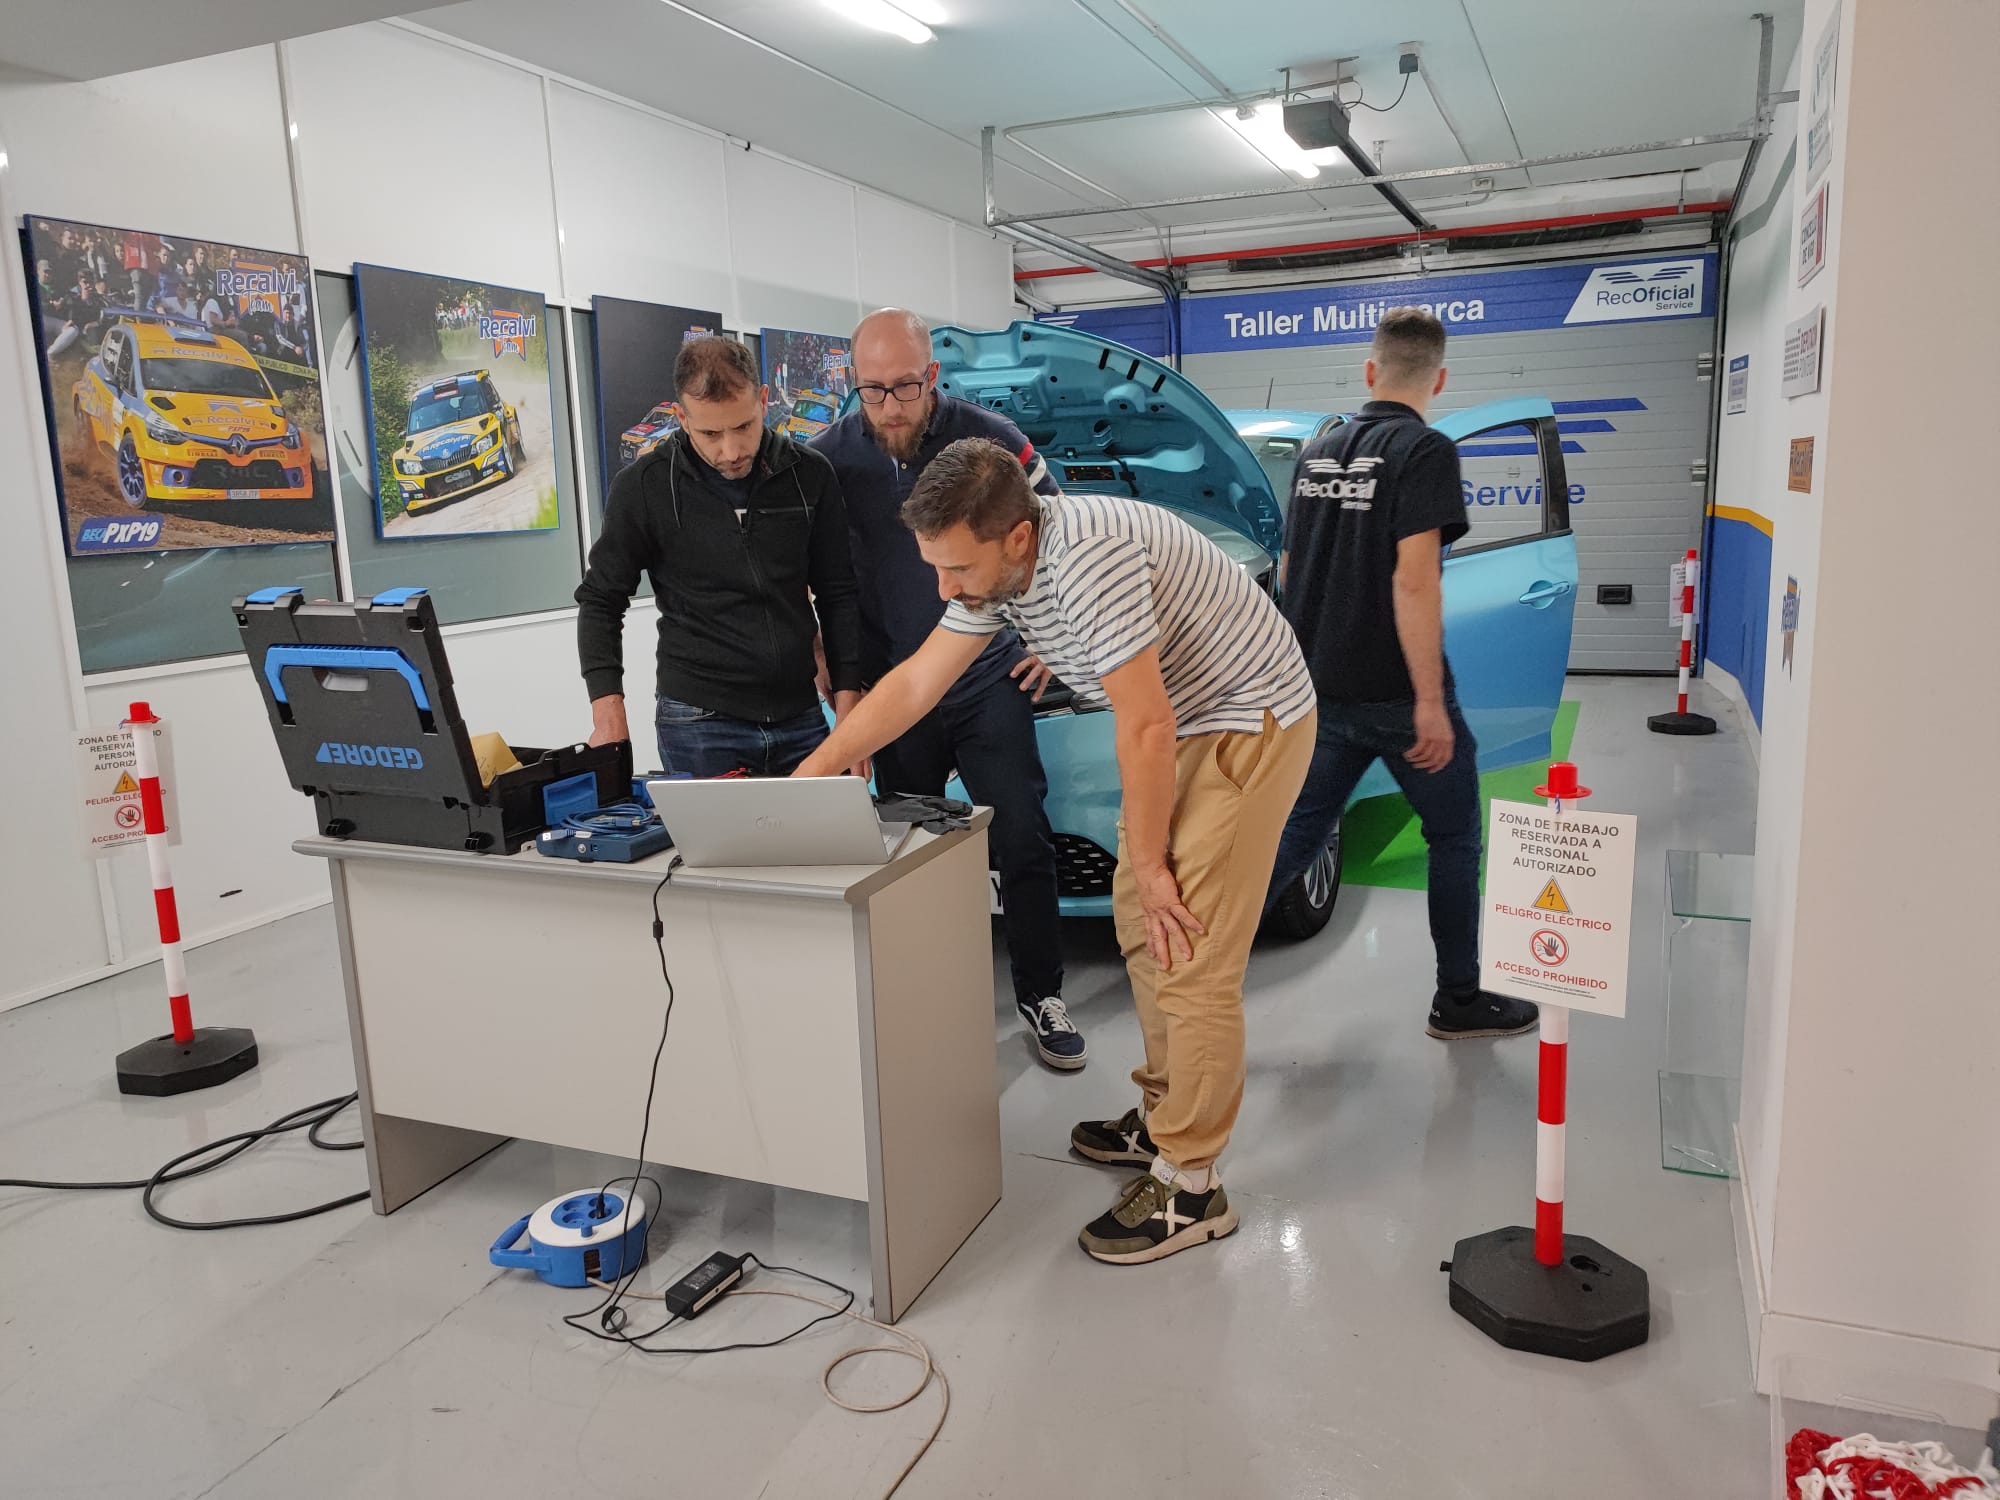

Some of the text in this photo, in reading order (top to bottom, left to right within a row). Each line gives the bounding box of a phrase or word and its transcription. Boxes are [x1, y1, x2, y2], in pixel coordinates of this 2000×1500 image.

[216, 268, 297, 296] Recalvi
[1596, 283, 1694, 306] RecOficial
[1656, 301, 1693, 310] Service
[479, 314, 536, 339] Recalvi
[1224, 299, 1485, 338] Taller Multiarca
[208, 416, 256, 426] Recalvi
[1460, 478, 1585, 506] Servie
[78, 736, 103, 745] ZONA
[107, 734, 118, 742] DE
[328, 743, 423, 769] GEDORE
[86, 795, 121, 806] PELIGRO
[1498, 813, 1619, 837] ZONA DE TRABAJO
[91, 832, 124, 844] ACCESO
[1511, 828, 1601, 848] RESERVADA A
[1520, 843, 1590, 862] PERSONAL
[1513, 857, 1596, 877] AUTORIZADO
[1495, 903, 1612, 931] PELIGRO ELÉCTRICO
[1495, 960, 1540, 977] ACCESO
[1543, 971, 1608, 990] PROHIBIDO
